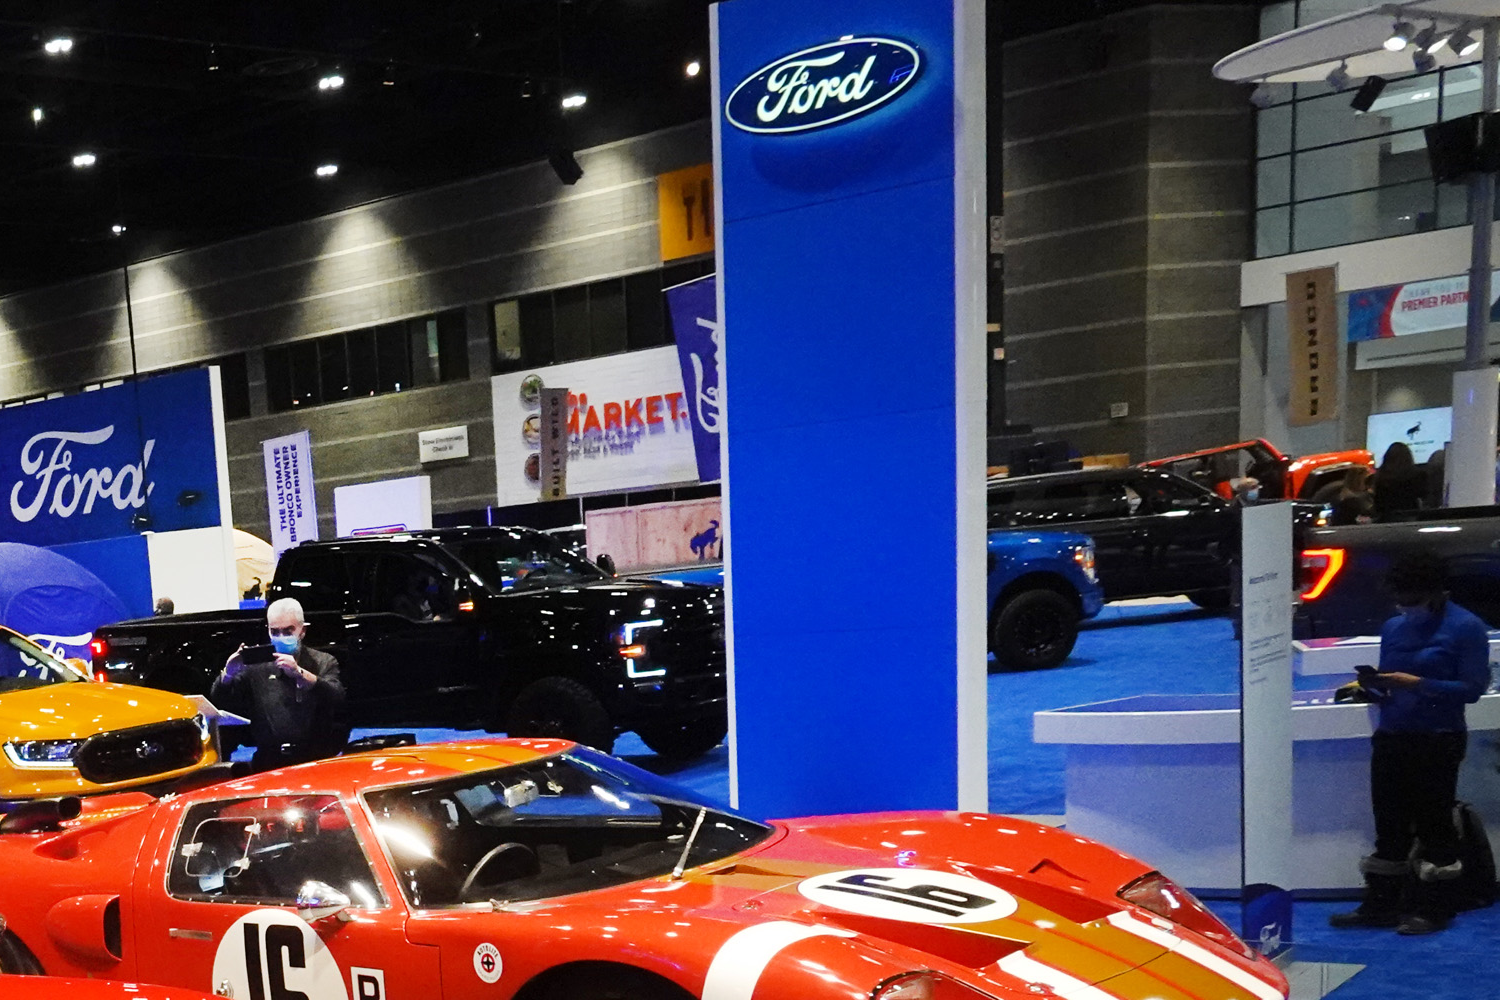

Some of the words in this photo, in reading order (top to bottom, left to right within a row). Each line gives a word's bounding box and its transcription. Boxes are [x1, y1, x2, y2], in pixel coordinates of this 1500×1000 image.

[757, 51, 876, 122] Ford
[1402, 296, 1439, 312] PREMIER
[1441, 291, 1468, 306] PARTN
[10, 424, 155, 523] Ford
[273, 446, 285, 505] ULTIMATE
[282, 445, 293, 490] OWNER
[290, 443, 303, 519] EXPERIENCE
[279, 508, 288, 532] THE
[286, 493, 297, 542] BRONCO
[816, 874, 997, 917] 16
